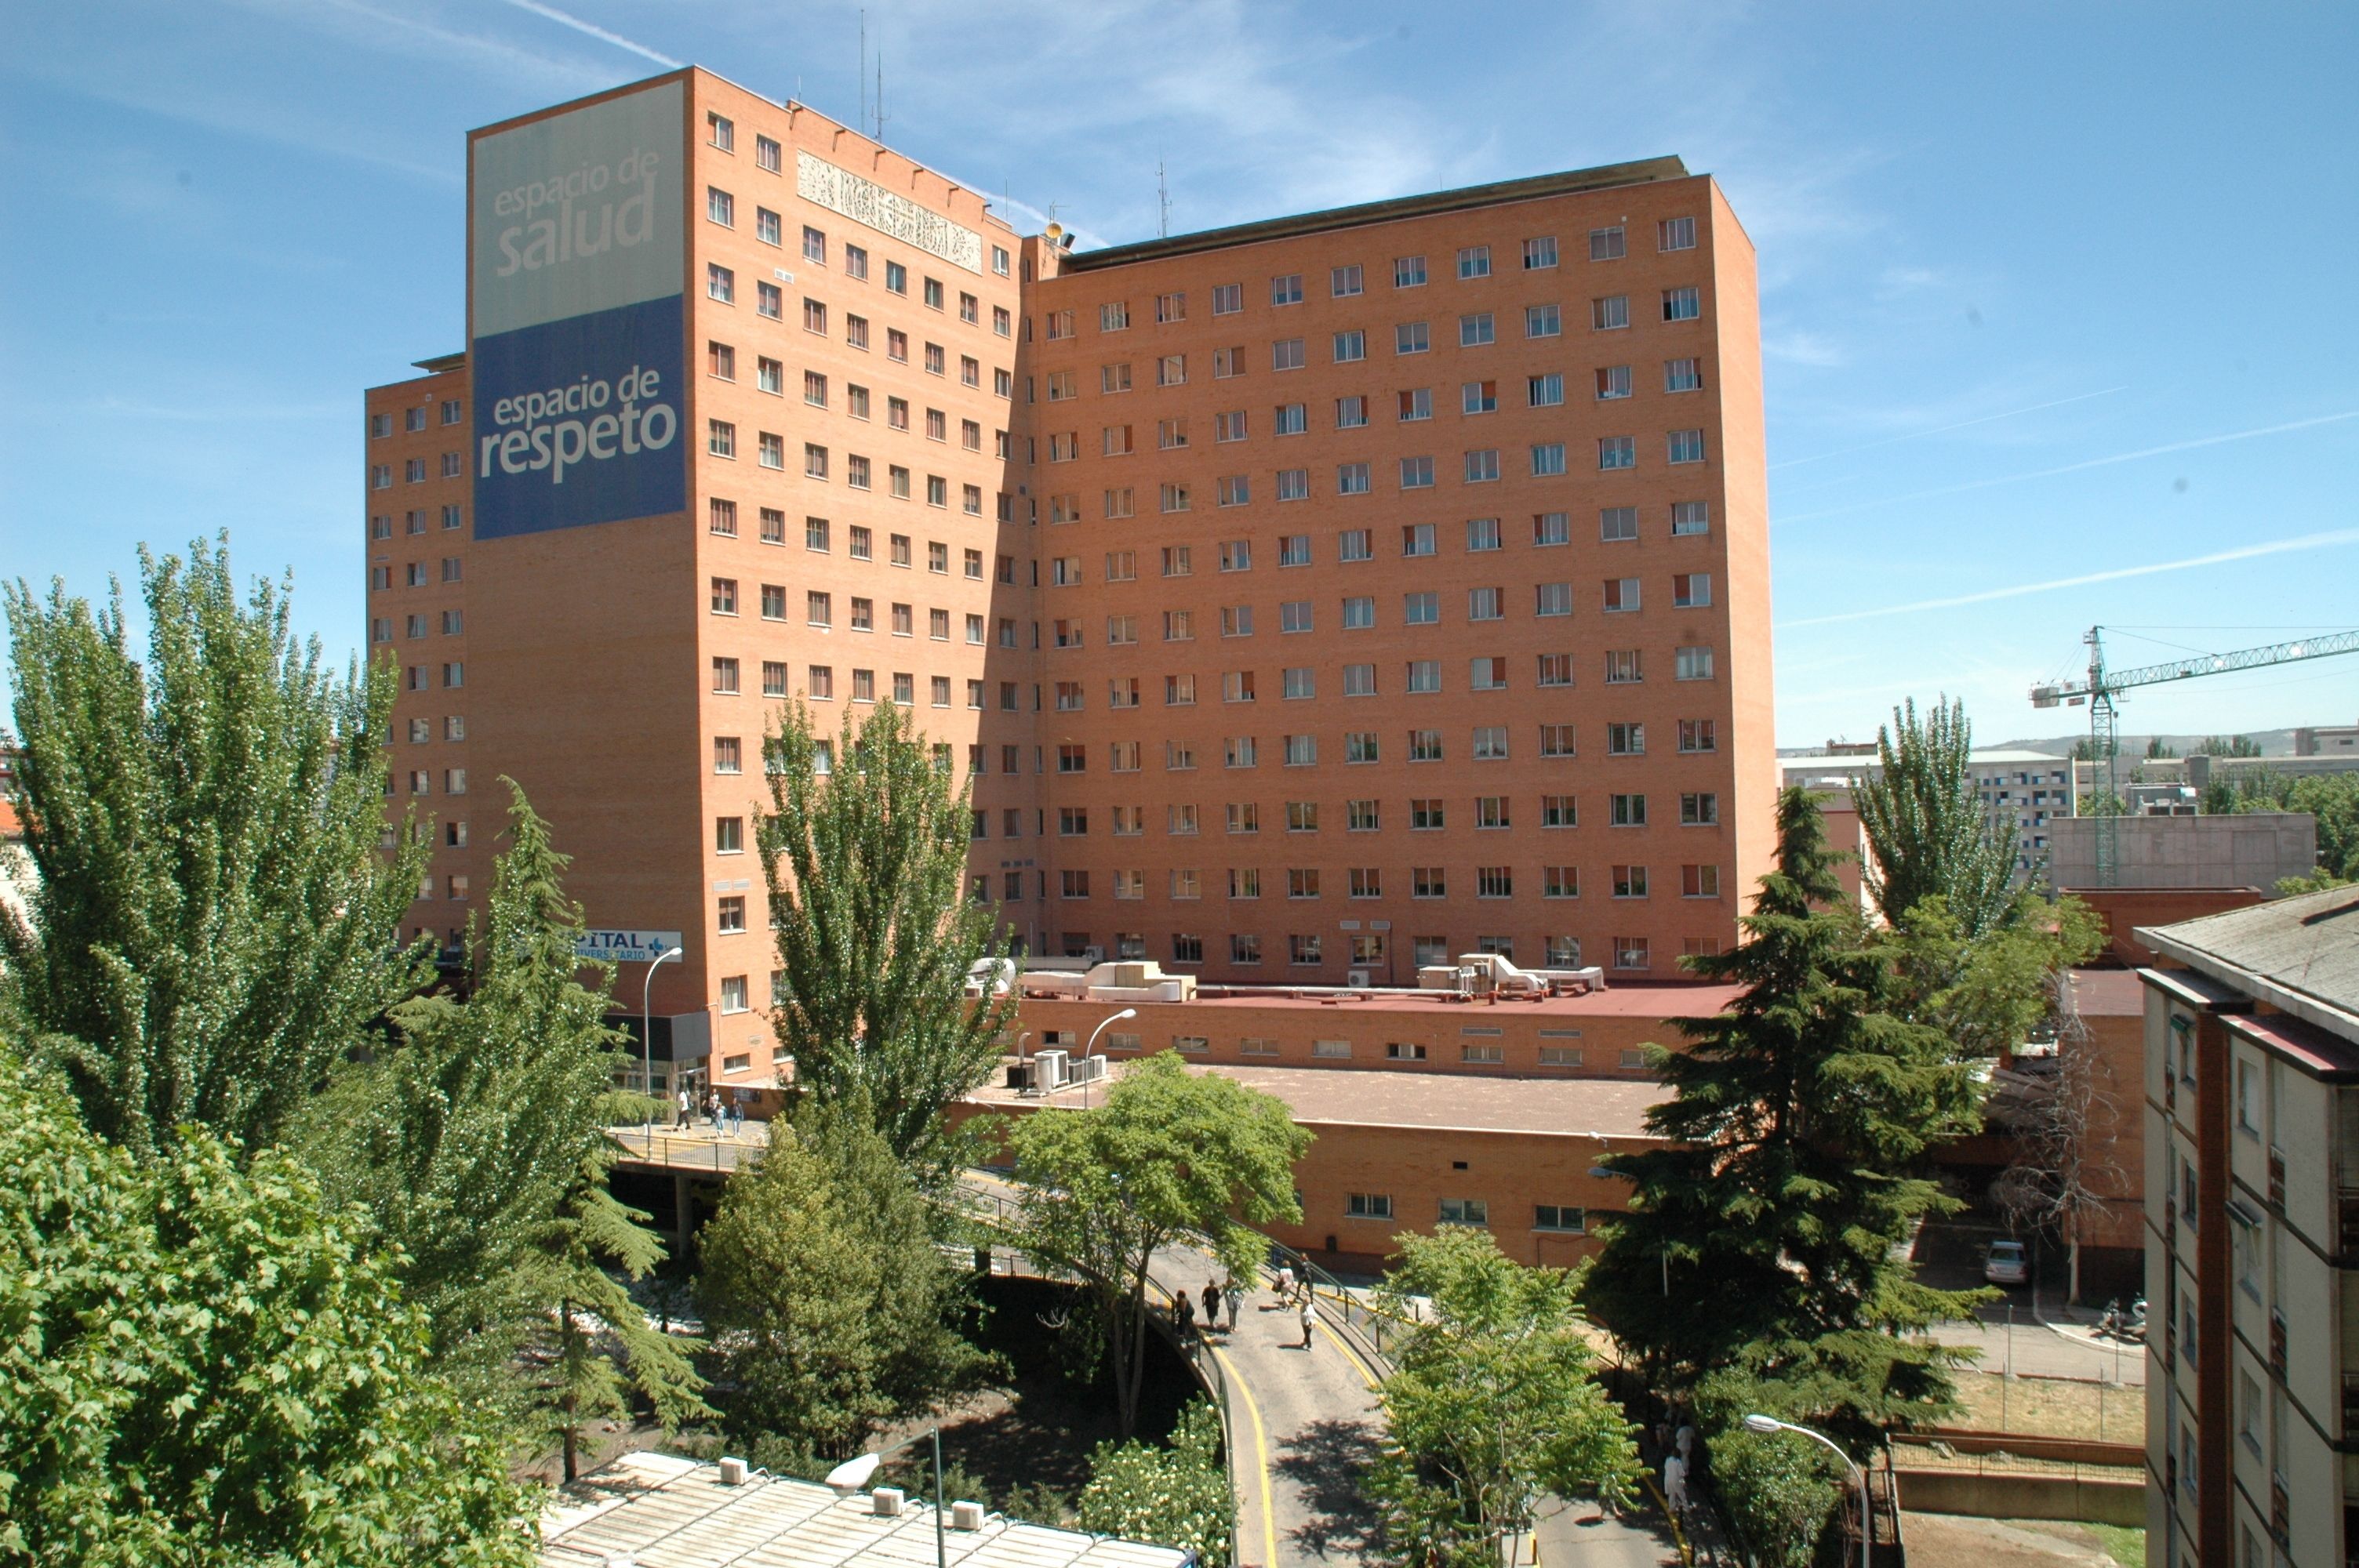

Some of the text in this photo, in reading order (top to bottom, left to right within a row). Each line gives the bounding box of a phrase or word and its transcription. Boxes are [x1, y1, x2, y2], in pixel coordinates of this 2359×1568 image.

[495, 147, 660, 220] espacio de
[496, 173, 656, 277] salud
[494, 365, 660, 430] espacio de
[481, 402, 677, 485] respeto
